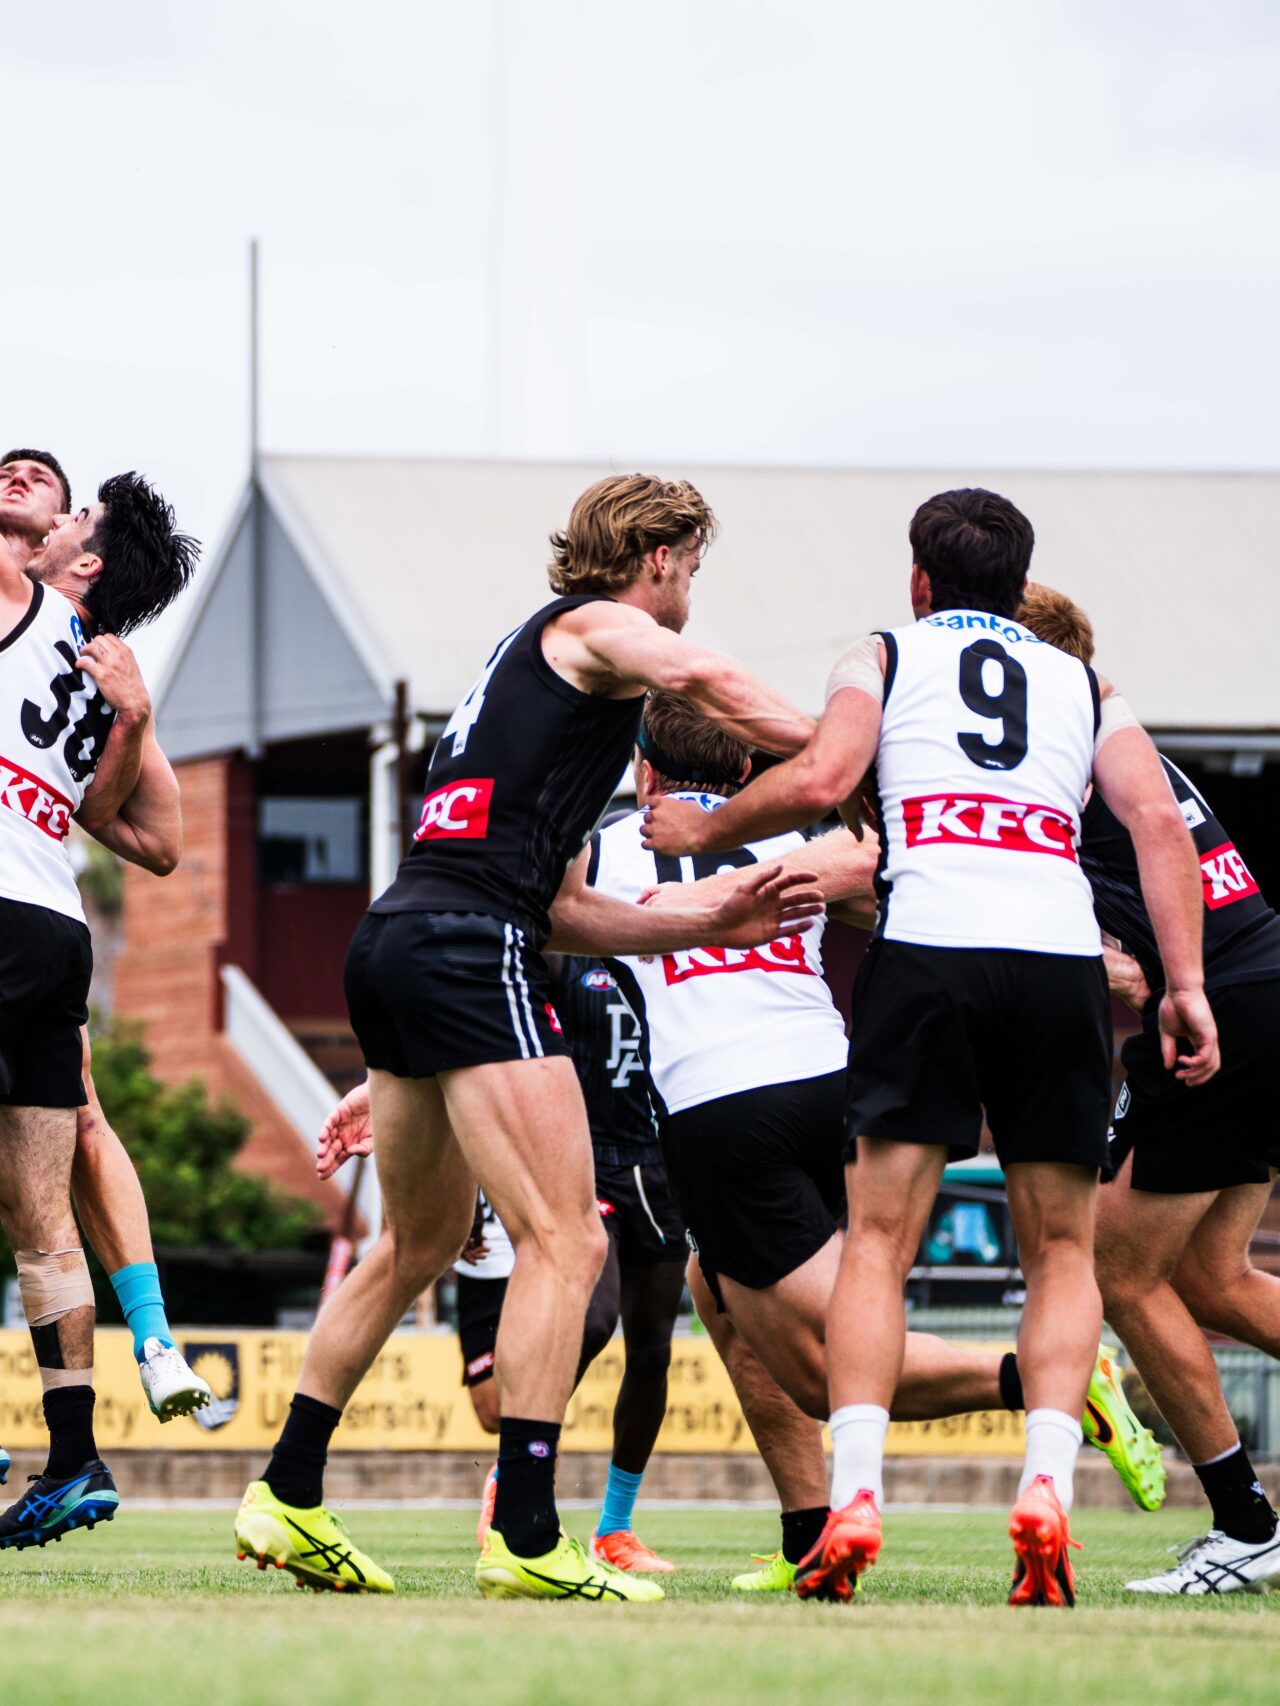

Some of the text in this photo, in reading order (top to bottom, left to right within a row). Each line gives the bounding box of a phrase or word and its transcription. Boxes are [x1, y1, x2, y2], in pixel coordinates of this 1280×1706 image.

[957, 638, 1028, 770] 9
[915, 799, 1068, 851] KFC
[1200, 848, 1256, 900] KF
